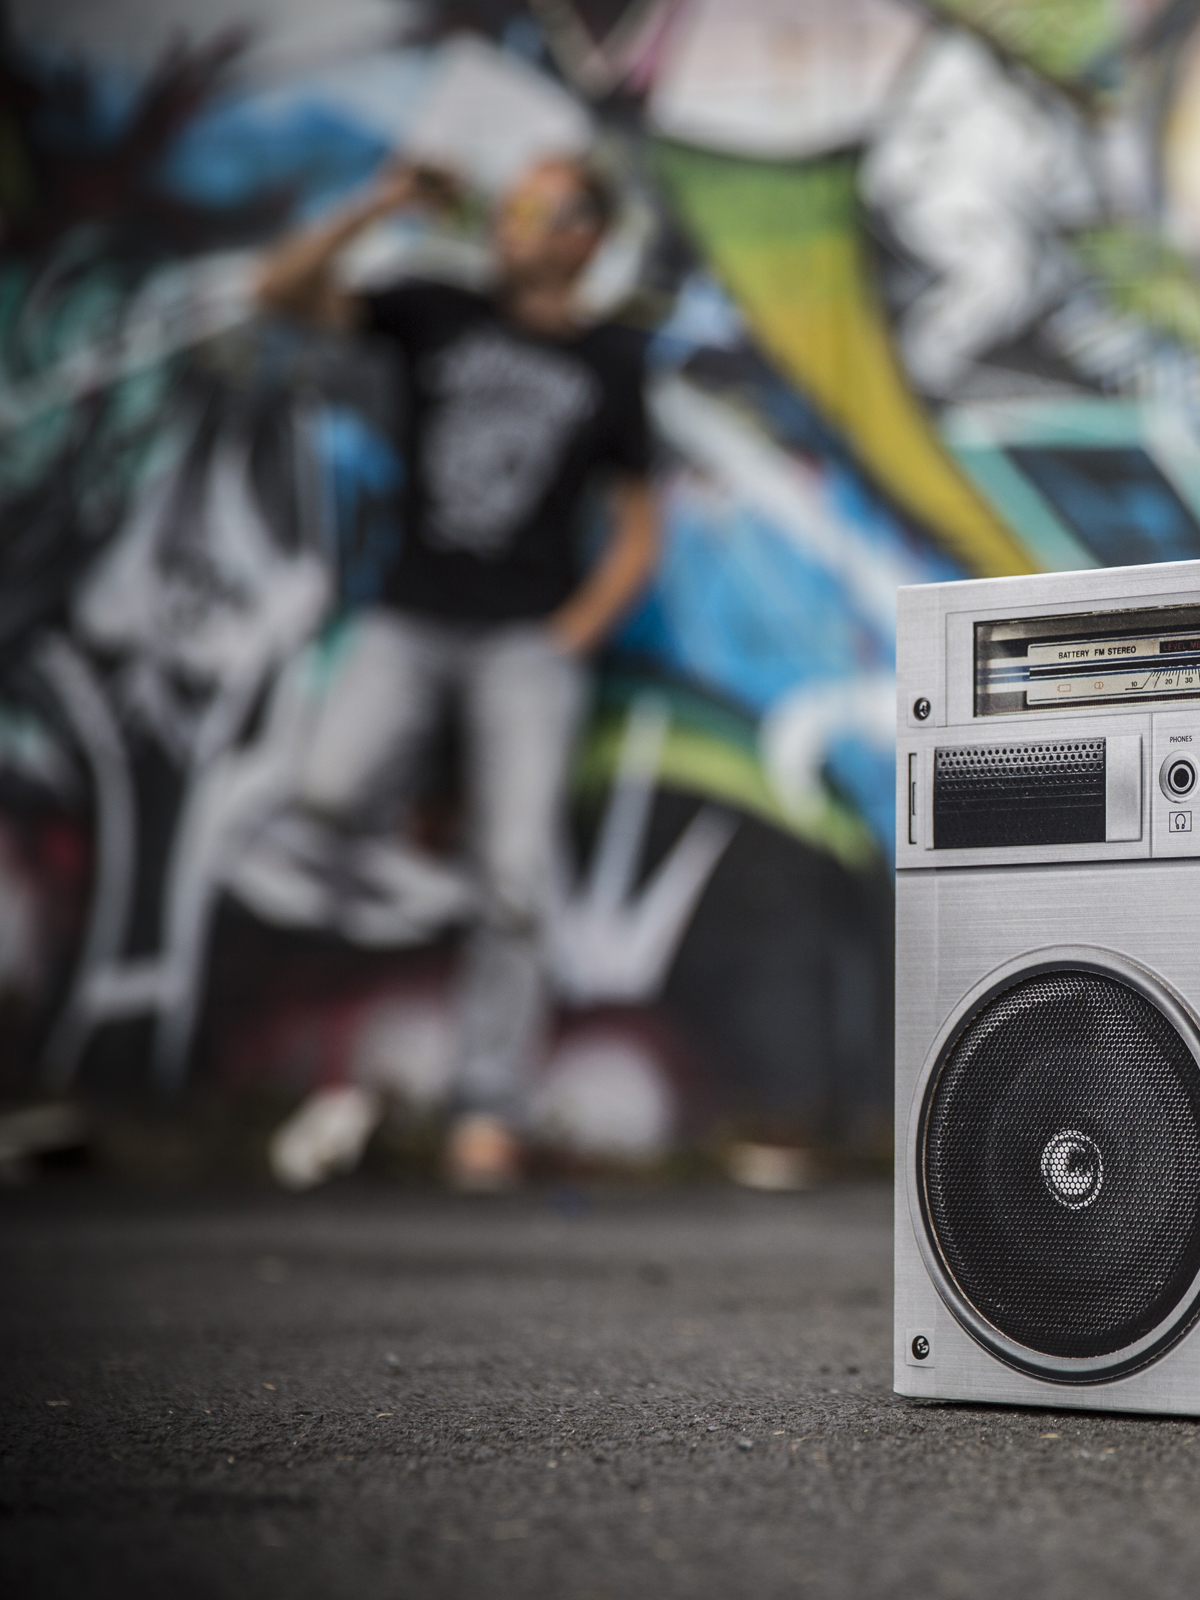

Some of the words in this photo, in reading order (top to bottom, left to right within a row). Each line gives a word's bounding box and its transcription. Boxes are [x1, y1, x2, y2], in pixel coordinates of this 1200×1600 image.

[1163, 641, 1188, 651] LEVEL
[1058, 649, 1089, 659] BATTERY
[1094, 648, 1105, 657] FM
[1107, 646, 1136, 656] STEREO
[1184, 676, 1193, 684] 30
[1169, 735, 1193, 743] PHONES
